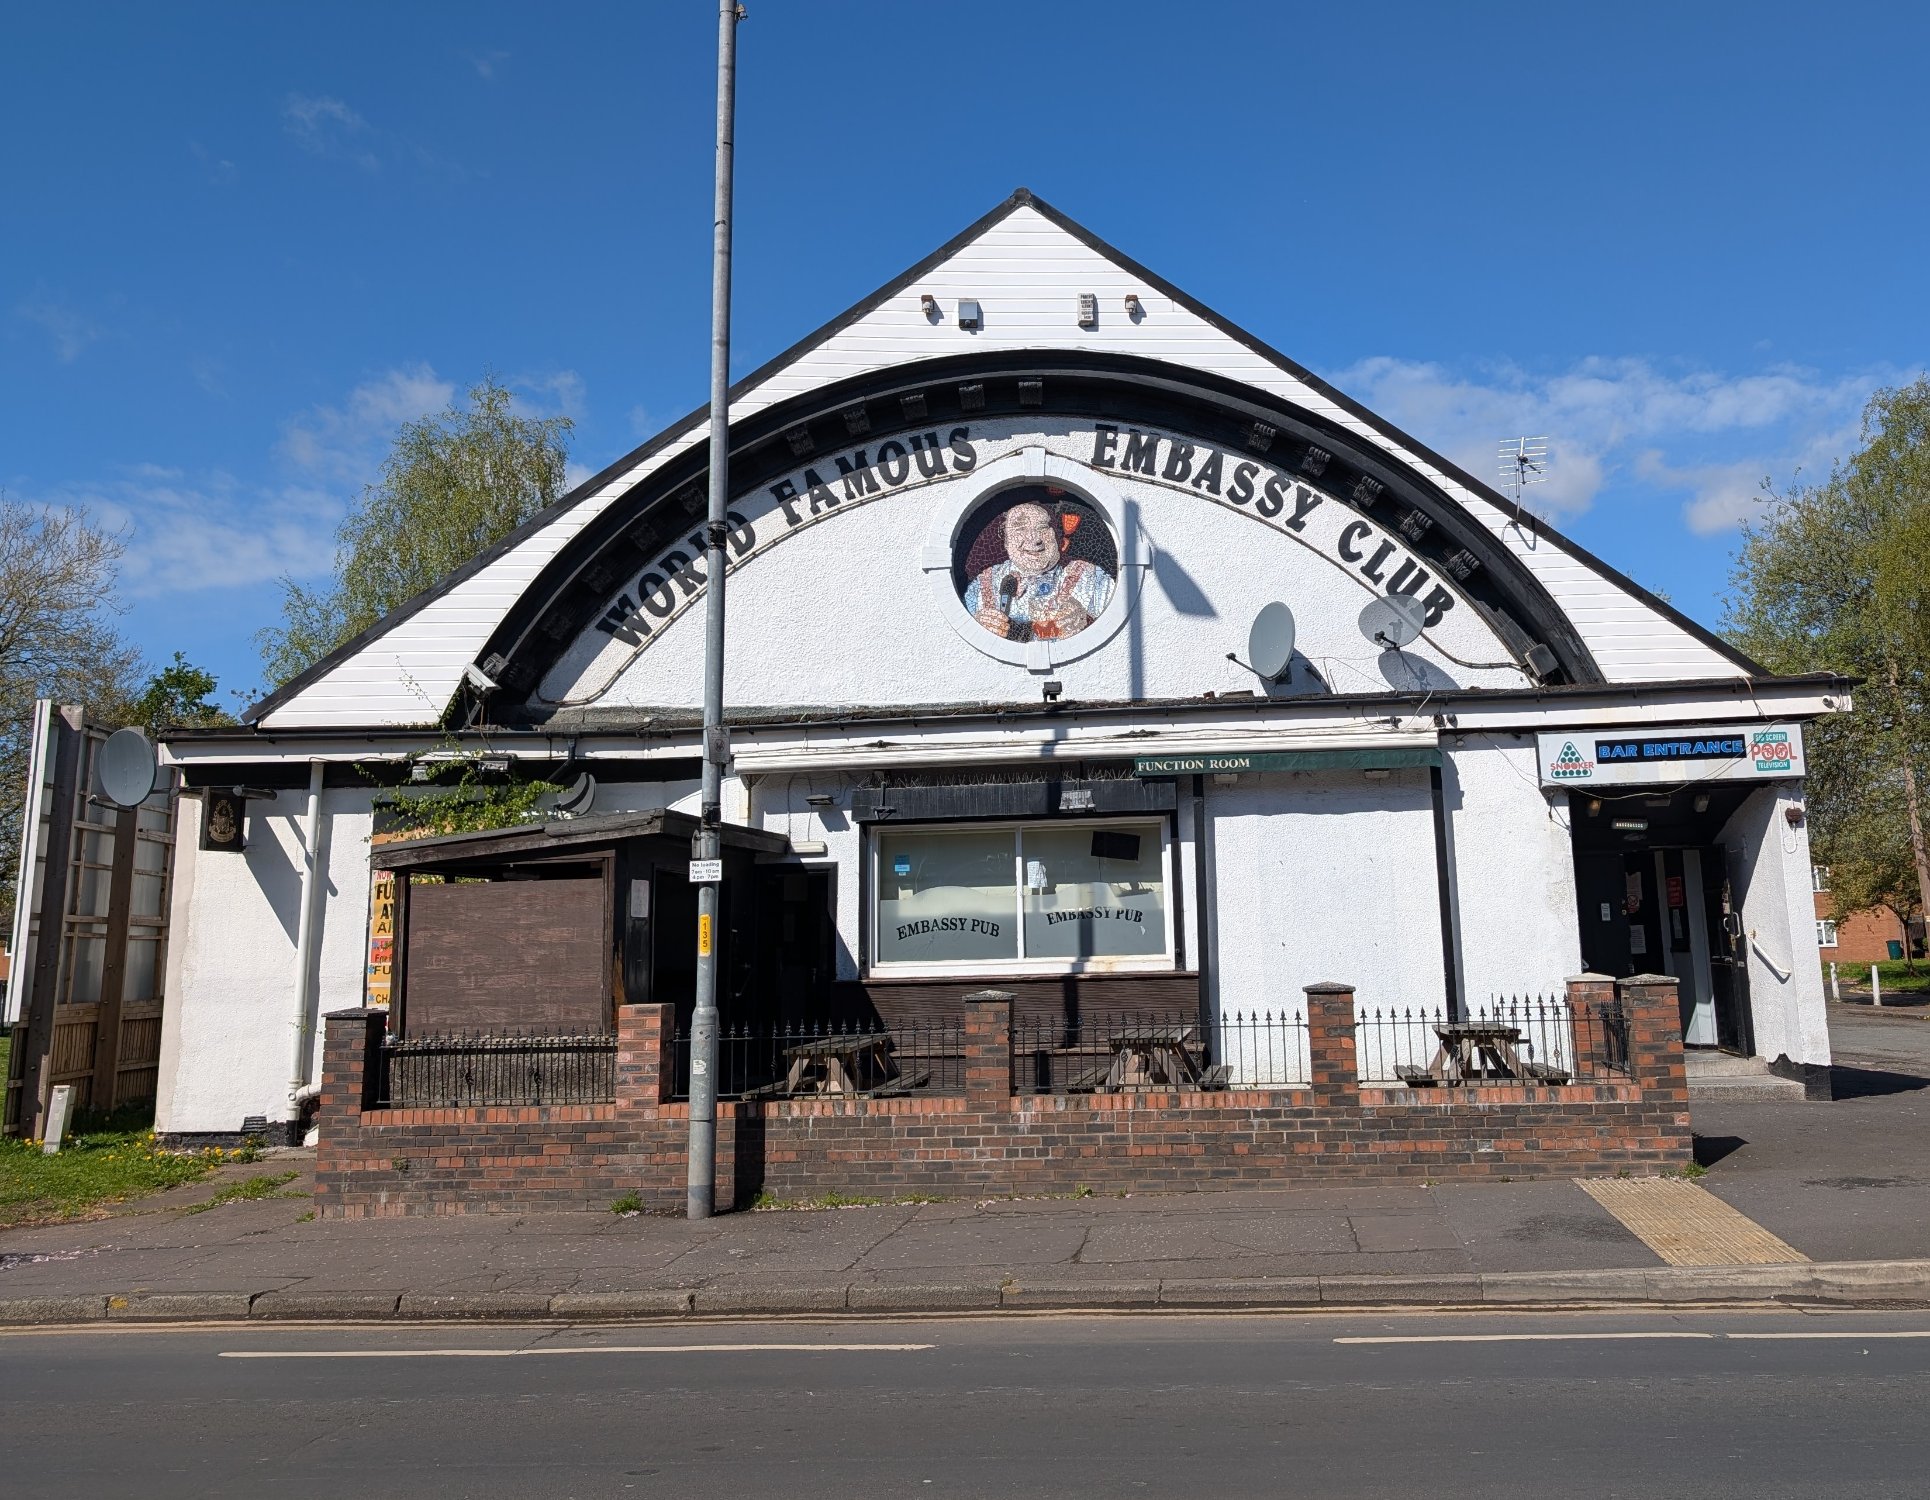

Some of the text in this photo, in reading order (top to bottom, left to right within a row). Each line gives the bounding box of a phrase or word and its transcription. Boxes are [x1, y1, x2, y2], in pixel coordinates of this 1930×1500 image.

[769, 426, 977, 528] FAMOUS
[1091, 423, 1323, 532] EMBASSY
[1338, 520, 1455, 628] CLUB
[1766, 733, 1786, 741] SCREEN
[1598, 740, 1744, 758] BAR ENTRANCE
[1750, 742, 1798, 761] POOL
[1138, 757, 1251, 772] FUNCTION ROOM
[1550, 761, 1594, 771] SNOOKER
[1757, 761, 1788, 769] TELEVISION
[1046, 905, 1143, 925] EMBASSY PUB
[896, 917, 1000, 940] EMBASSY PUB
